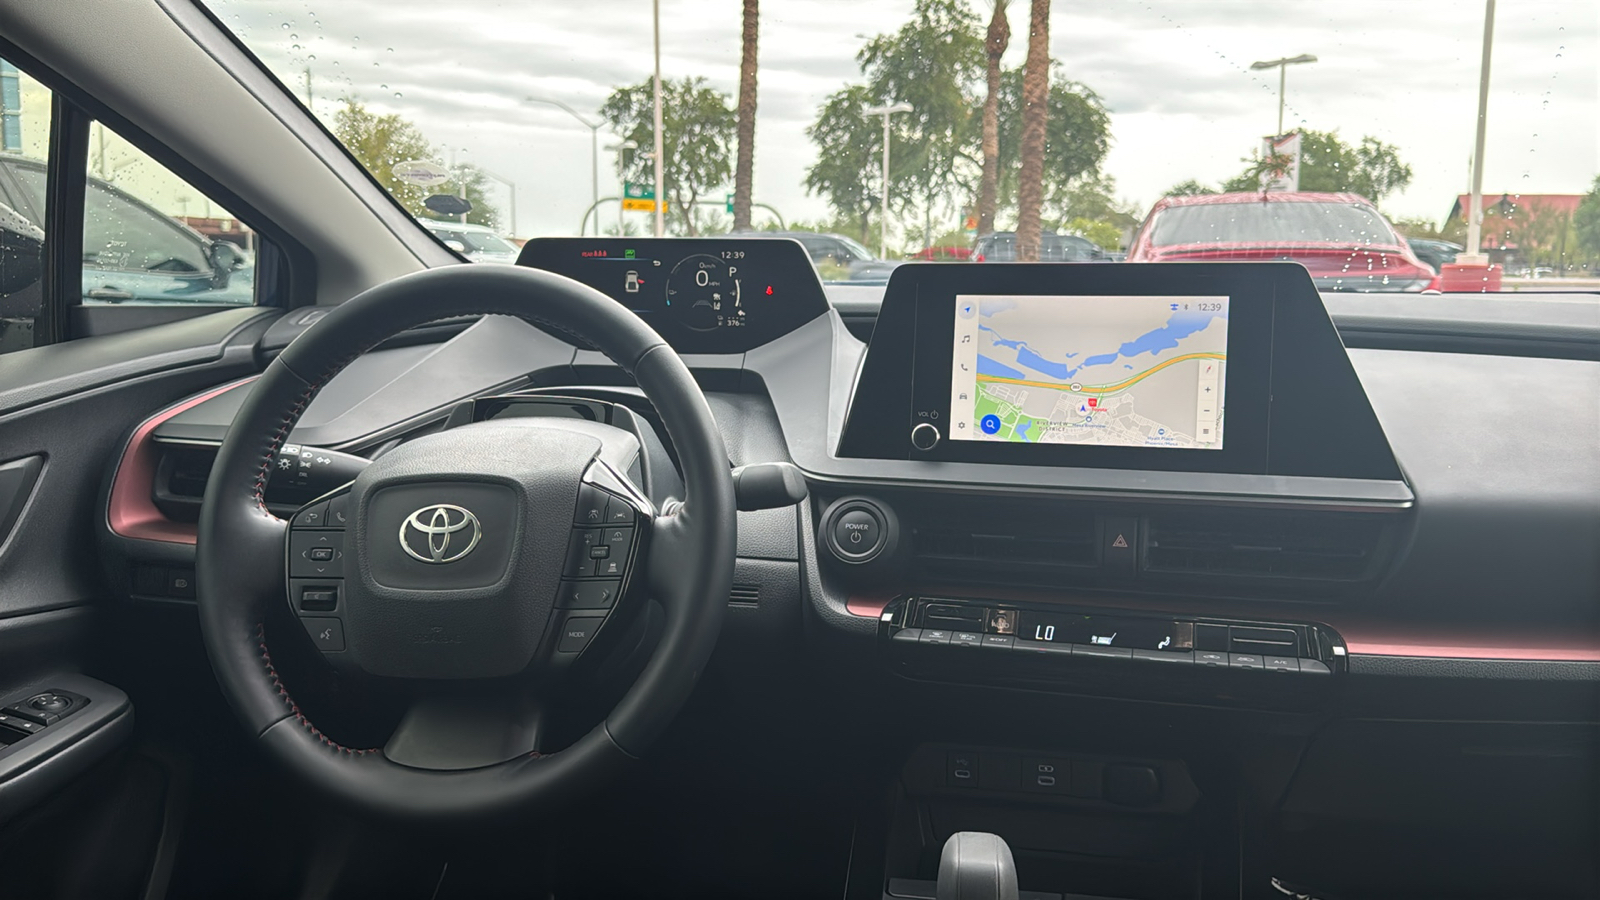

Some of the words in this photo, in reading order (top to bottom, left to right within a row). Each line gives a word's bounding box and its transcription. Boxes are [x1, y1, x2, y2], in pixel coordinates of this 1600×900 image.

[721, 251, 745, 259] 12:39
[729, 266, 737, 277] P
[695, 270, 709, 287] 0
[1198, 303, 1222, 312] 12:39
[845, 523, 869, 531] POWER
[1035, 624, 1055, 641] LO
